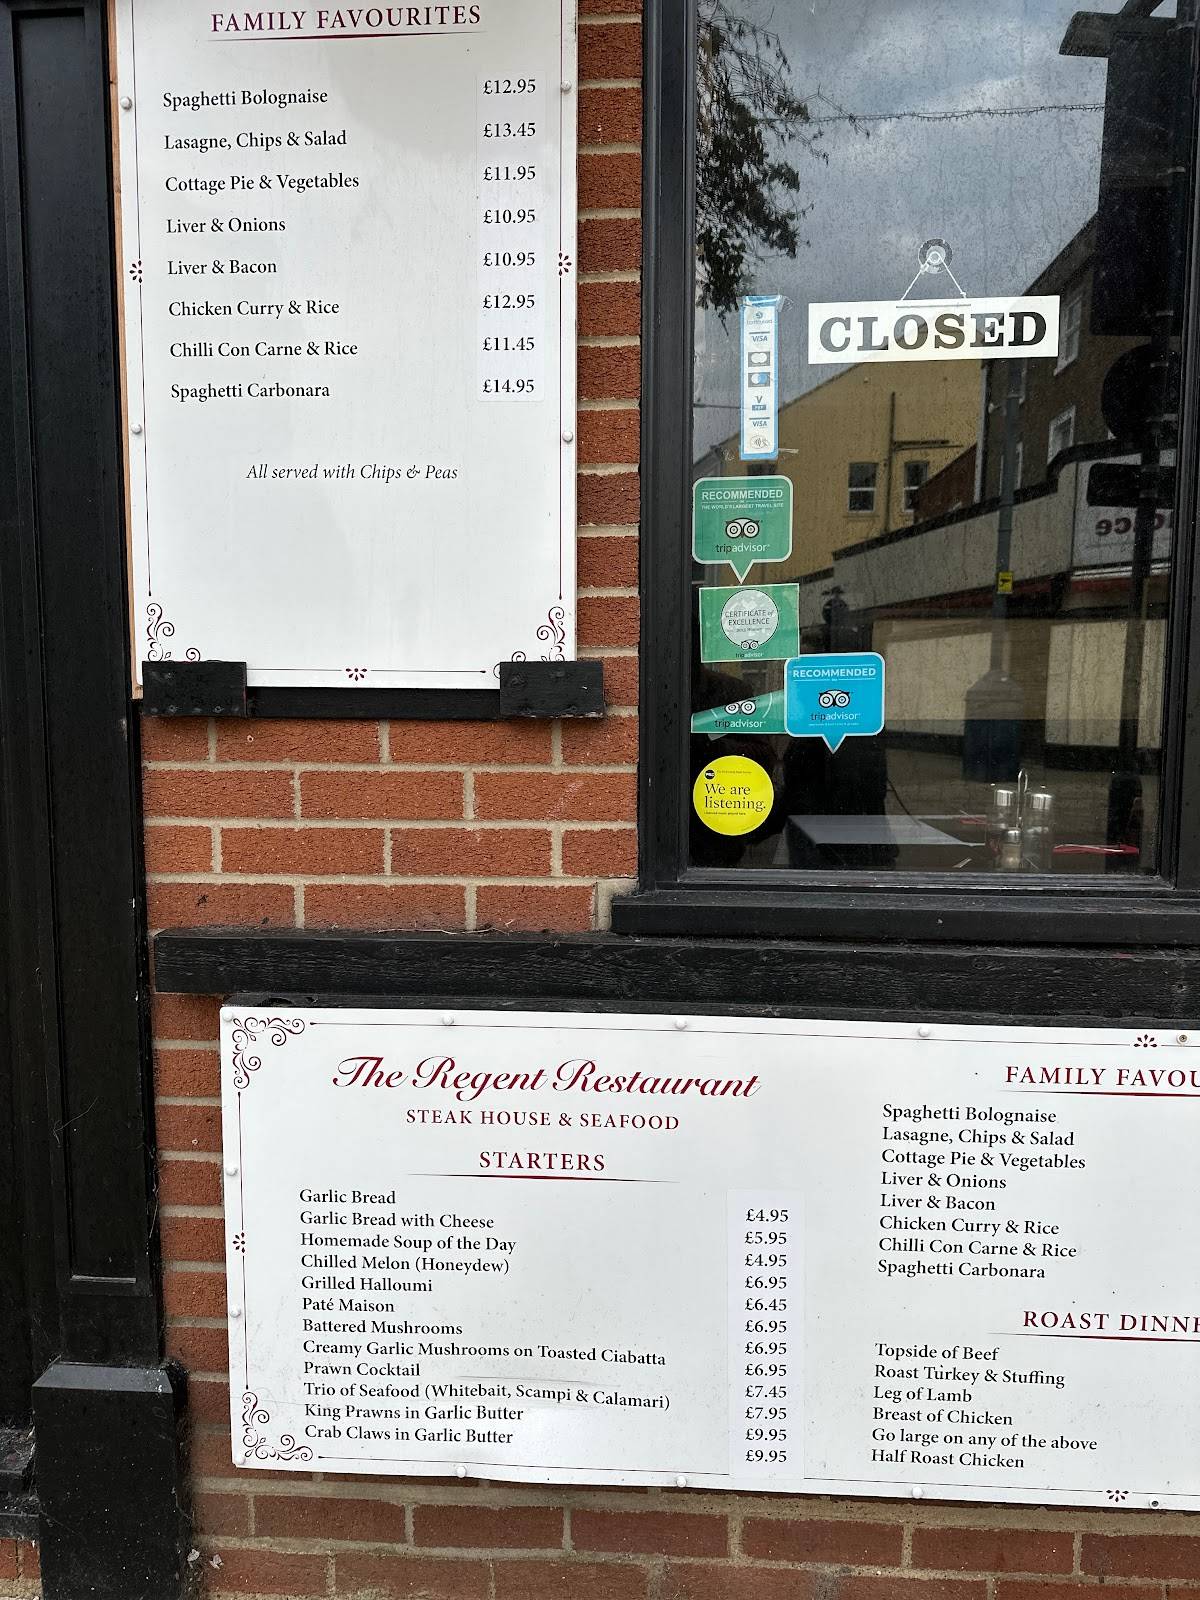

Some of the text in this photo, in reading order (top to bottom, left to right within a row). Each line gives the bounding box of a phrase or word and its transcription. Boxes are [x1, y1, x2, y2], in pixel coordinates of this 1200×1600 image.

[211, 5, 480, 32] FAMILY FAVOURITES
[483, 79, 536, 95] £12.95
[163, 89, 328, 112] Spaghetti Bolognaise
[483, 122, 536, 138] £13.45
[164, 130, 347, 154] Lasagne, Chips & Salad
[483, 166, 536, 181] £11.95
[166, 172, 359, 195] Cottage Pie & Vegetables
[483, 209, 535, 224] £10.95
[167, 218, 286, 233] Liver & Onions
[483, 252, 535, 267] £10.95
[168, 260, 277, 275] Liver & Bacon
[483, 295, 535, 309] £12.95
[169, 300, 339, 320] Chicken Curry & Rice
[819, 311, 1047, 353] CLOSED
[170, 342, 358, 357] Chilli Con Carne & Rice
[483, 337, 535, 351] £11.45
[172, 382, 330, 403] Spaghetti Carbonara
[483, 379, 534, 393] £14.95
[246, 464, 458, 484] All served with Chips & Peas
[701, 489, 783, 500] RECOMMENDED
[715, 543, 768, 555] tripadvisor
[725, 609, 767, 618] CERTIFICATE
[728, 617, 771, 626] EXCELLENCE
[792, 667, 876, 679] RECOMMENDED
[714, 718, 764, 729] tripadvisor
[810, 711, 861, 722] tripadvisor
[705, 783, 751, 796] We are
[705, 795, 767, 813] listening.
[332, 1055, 762, 1102] The Regent Restaurant
[1006, 1066, 1106, 1085] FAMILY
[407, 1110, 679, 1130] STEAK HOUSE & SEAFOOD
[883, 1104, 1057, 1126] Spaghetti Bolognaise
[883, 1127, 1074, 1148] Lasagne, Chips & Salad
[480, 1152, 605, 1171] STARTERS
[882, 1149, 1085, 1172] Cottage Pie & Vegetables
[300, 1189, 396, 1204] Garlic Bread
[746, 1209, 789, 1223] £4.95
[301, 1233, 517, 1255] Homemade Soup of the Day
[745, 1232, 787, 1245] £5.95
[302, 1254, 509, 1276] Chilled Melon (Honeydew)
[745, 1254, 787, 1267] £4.95
[878, 1260, 1045, 1278] Spaghetti Carbonara
[302, 1276, 432, 1292] Grilled Halloumi
[745, 1276, 787, 1289] £6.95
[303, 1298, 395, 1312] Paté Maison
[745, 1298, 787, 1311] £6.45
[303, 1319, 463, 1335] Battered Mushrooms
[745, 1320, 787, 1333] £6.95
[1024, 1311, 1109, 1330] ROAST
[304, 1340, 666, 1365] Creamy Garlic Mushrooms on Toasted Ciabatta
[745, 1342, 787, 1355] £6.95
[875, 1343, 1000, 1361] Topside of Beef
[304, 1362, 420, 1376] Prawn Cocktail
[745, 1364, 787, 1377] £6.95
[876, 1365, 1065, 1389] Roast Turkey & Stuffing
[304, 1382, 670, 1411] Trio of Seafood (Whitebait, Scampi & Calamari)
[745, 1385, 787, 1398] £7.45
[304, 1404, 524, 1421] King Prawns in Garlic Butter
[745, 1407, 787, 1420] £7.95
[873, 1407, 1013, 1426] Breast of Chicken
[745, 1428, 787, 1441] £9.95
[746, 1450, 787, 1463] £9.95
[872, 1449, 1024, 1468] Half Roast Chicken
